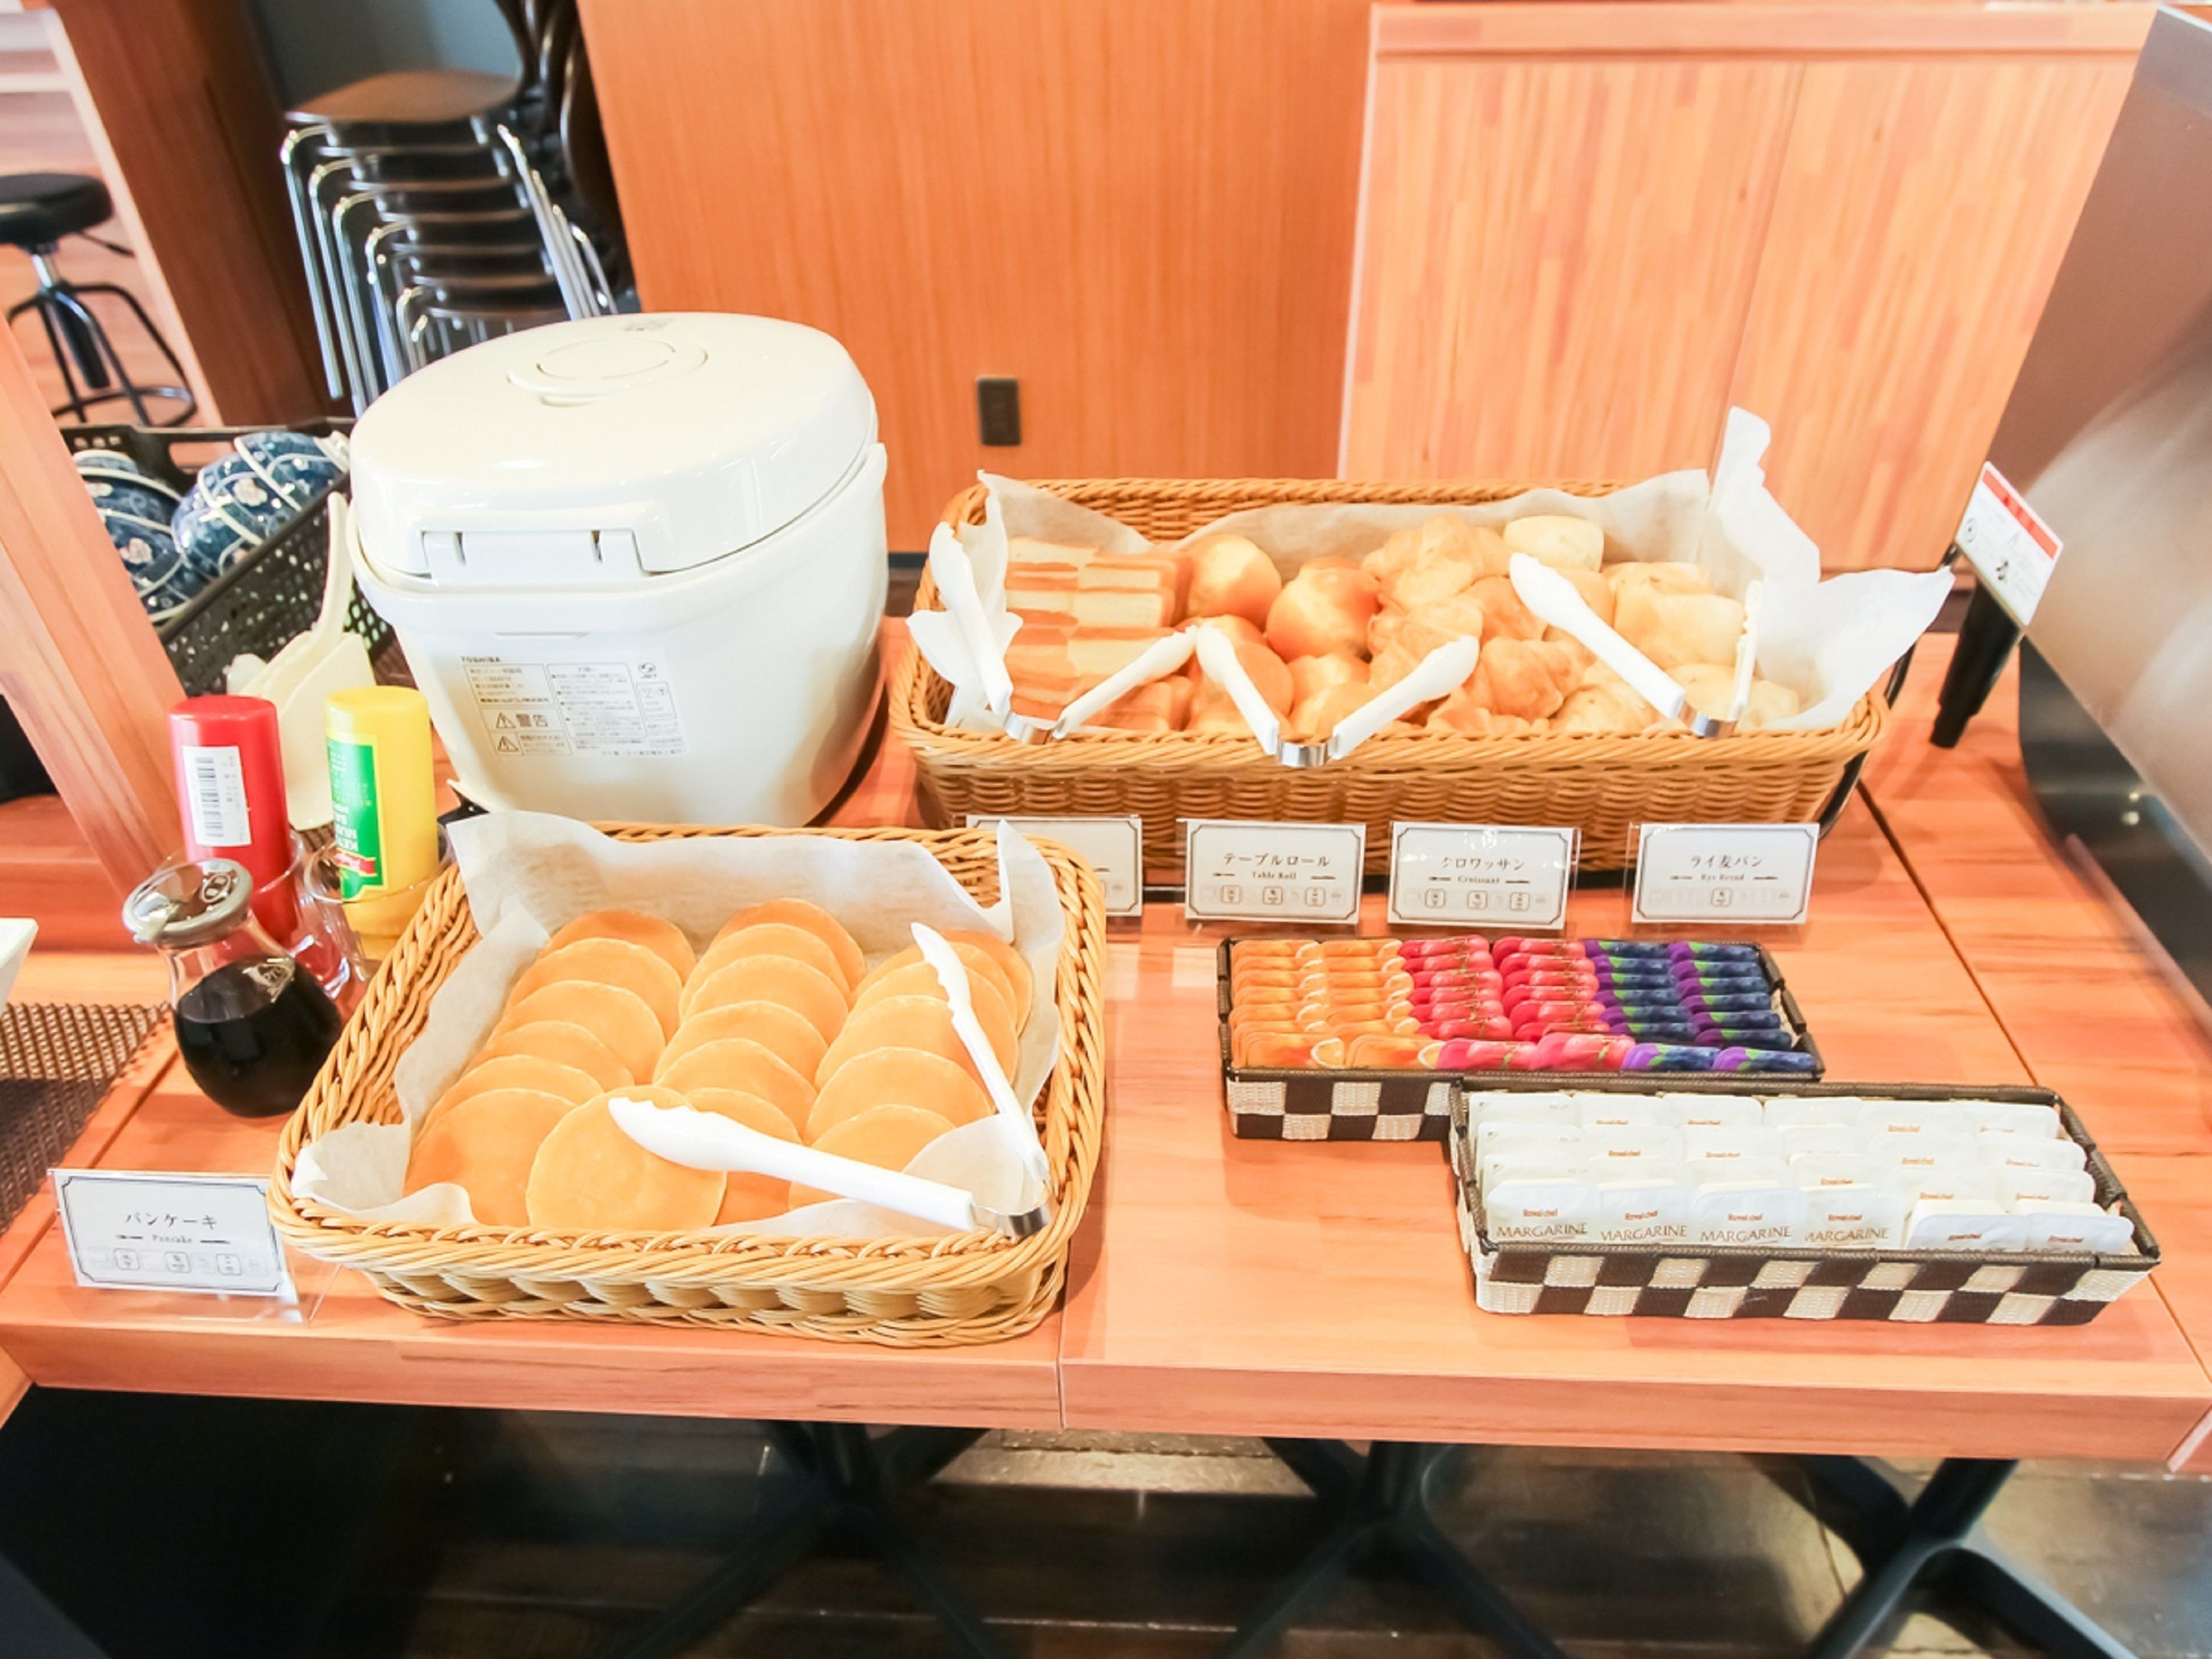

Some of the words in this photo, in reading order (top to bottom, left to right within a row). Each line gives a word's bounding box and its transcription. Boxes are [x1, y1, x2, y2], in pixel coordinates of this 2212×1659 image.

[1223, 853, 1330, 868] テーブルロール
[1441, 856, 1525, 871] クロワッサン
[1690, 854, 1763, 869] ライ麦パン
[1252, 871, 1276, 879] Table
[1457, 874, 1501, 884] Croissant
[125, 1211, 217, 1230] パンケーキ
[1497, 1222, 1588, 1238] MARGARINE
[1699, 1225, 1792, 1243] MARGARINE
